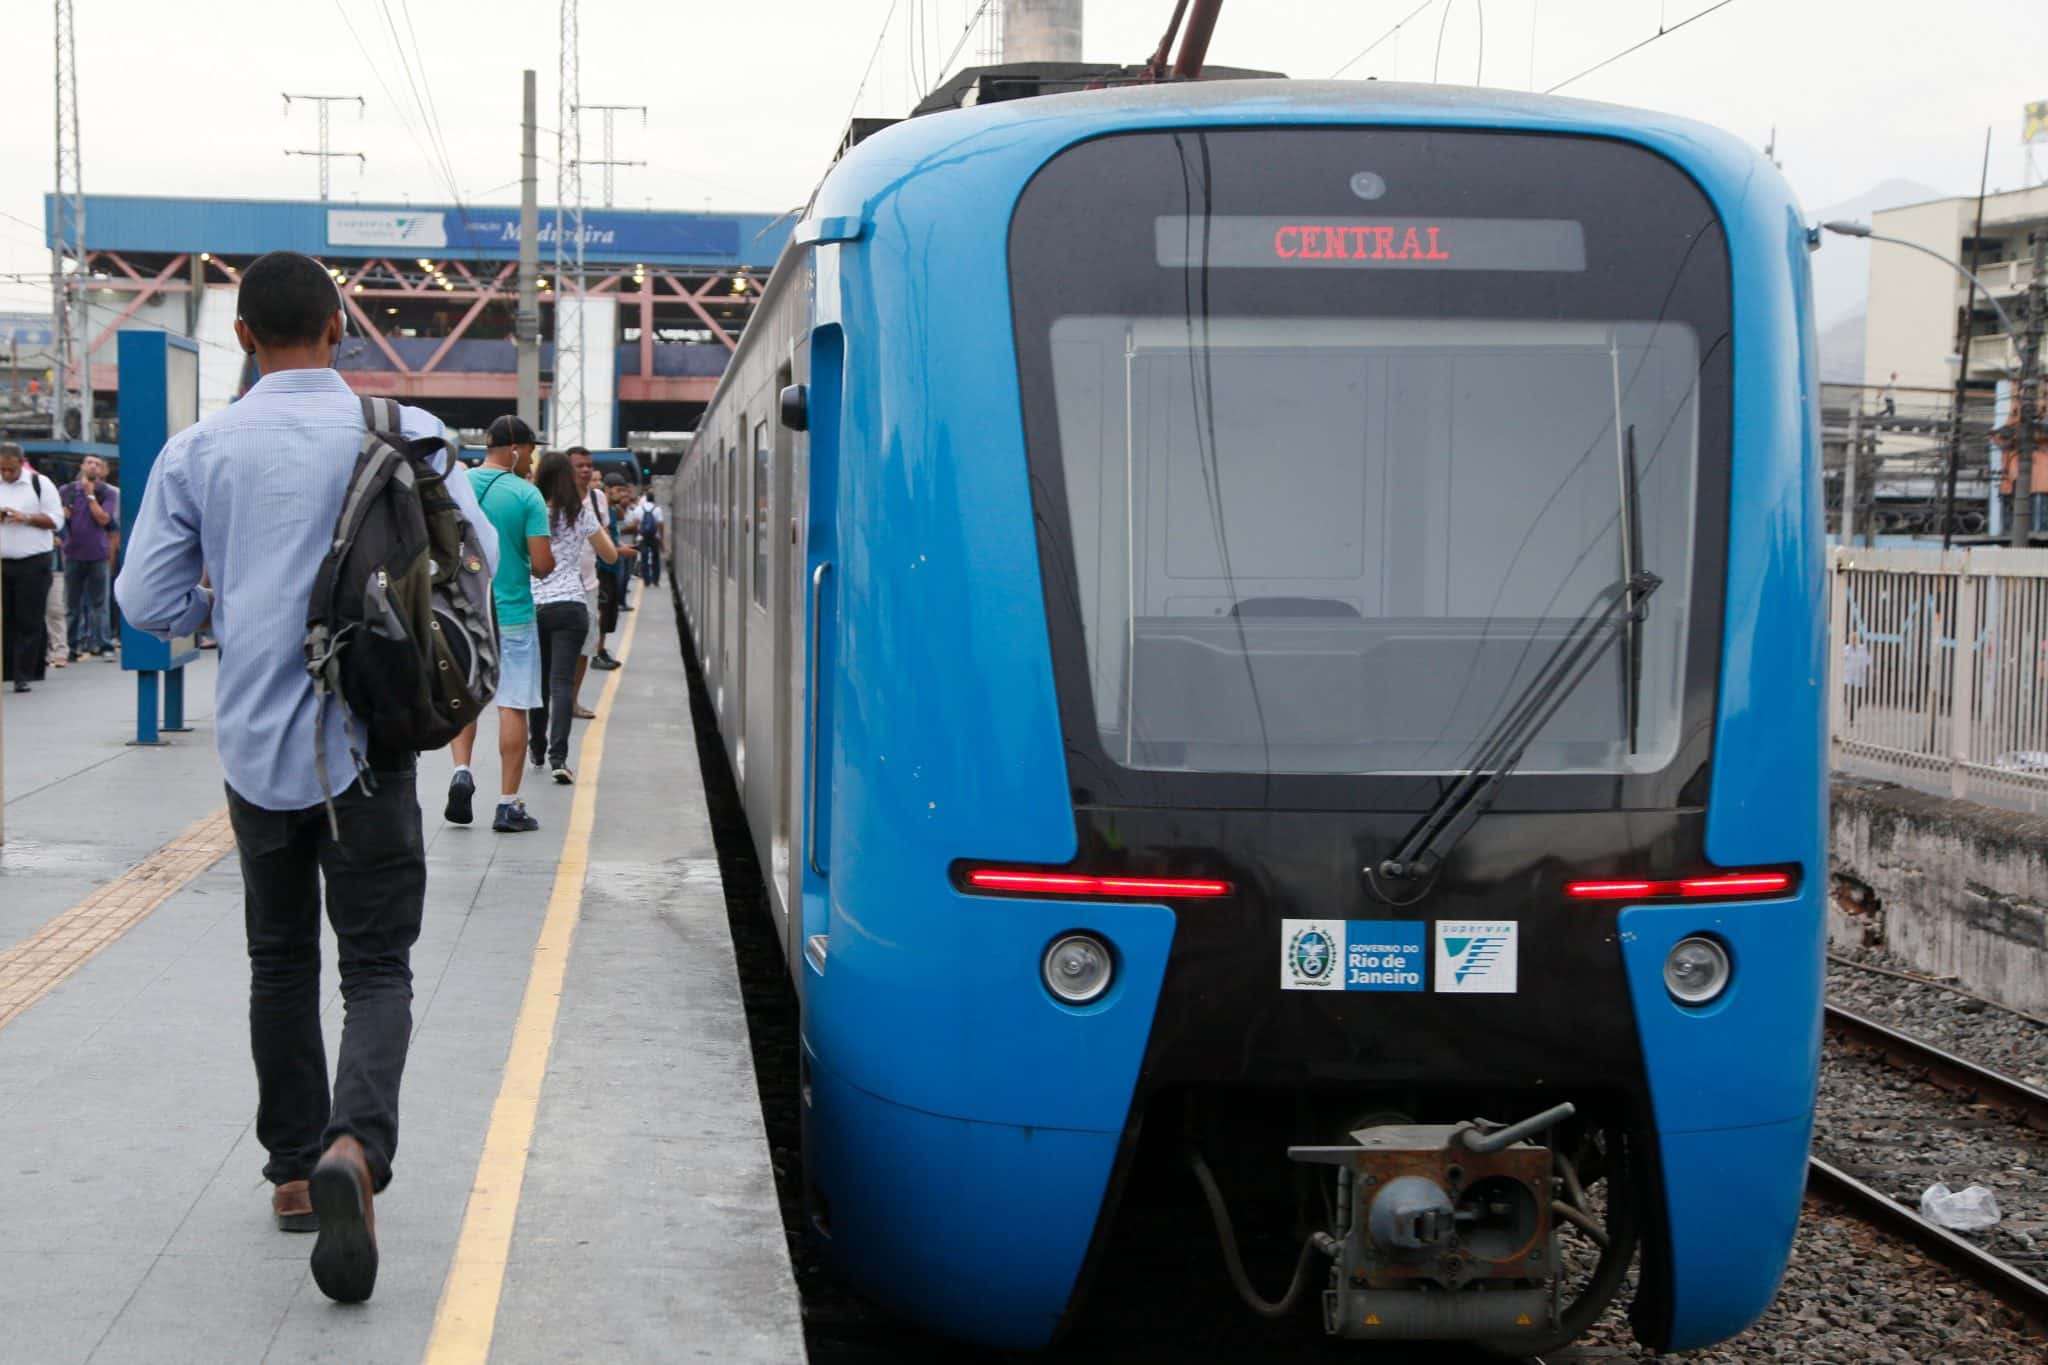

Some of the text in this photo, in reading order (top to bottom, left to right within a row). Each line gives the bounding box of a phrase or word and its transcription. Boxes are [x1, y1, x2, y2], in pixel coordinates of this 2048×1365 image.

[1275, 225, 1449, 259] CENTRAL
[1349, 944, 1419, 953] GOVERNO DO
[1349, 953, 1406, 968] Rio de
[1348, 969, 1419, 984] Janeiro
